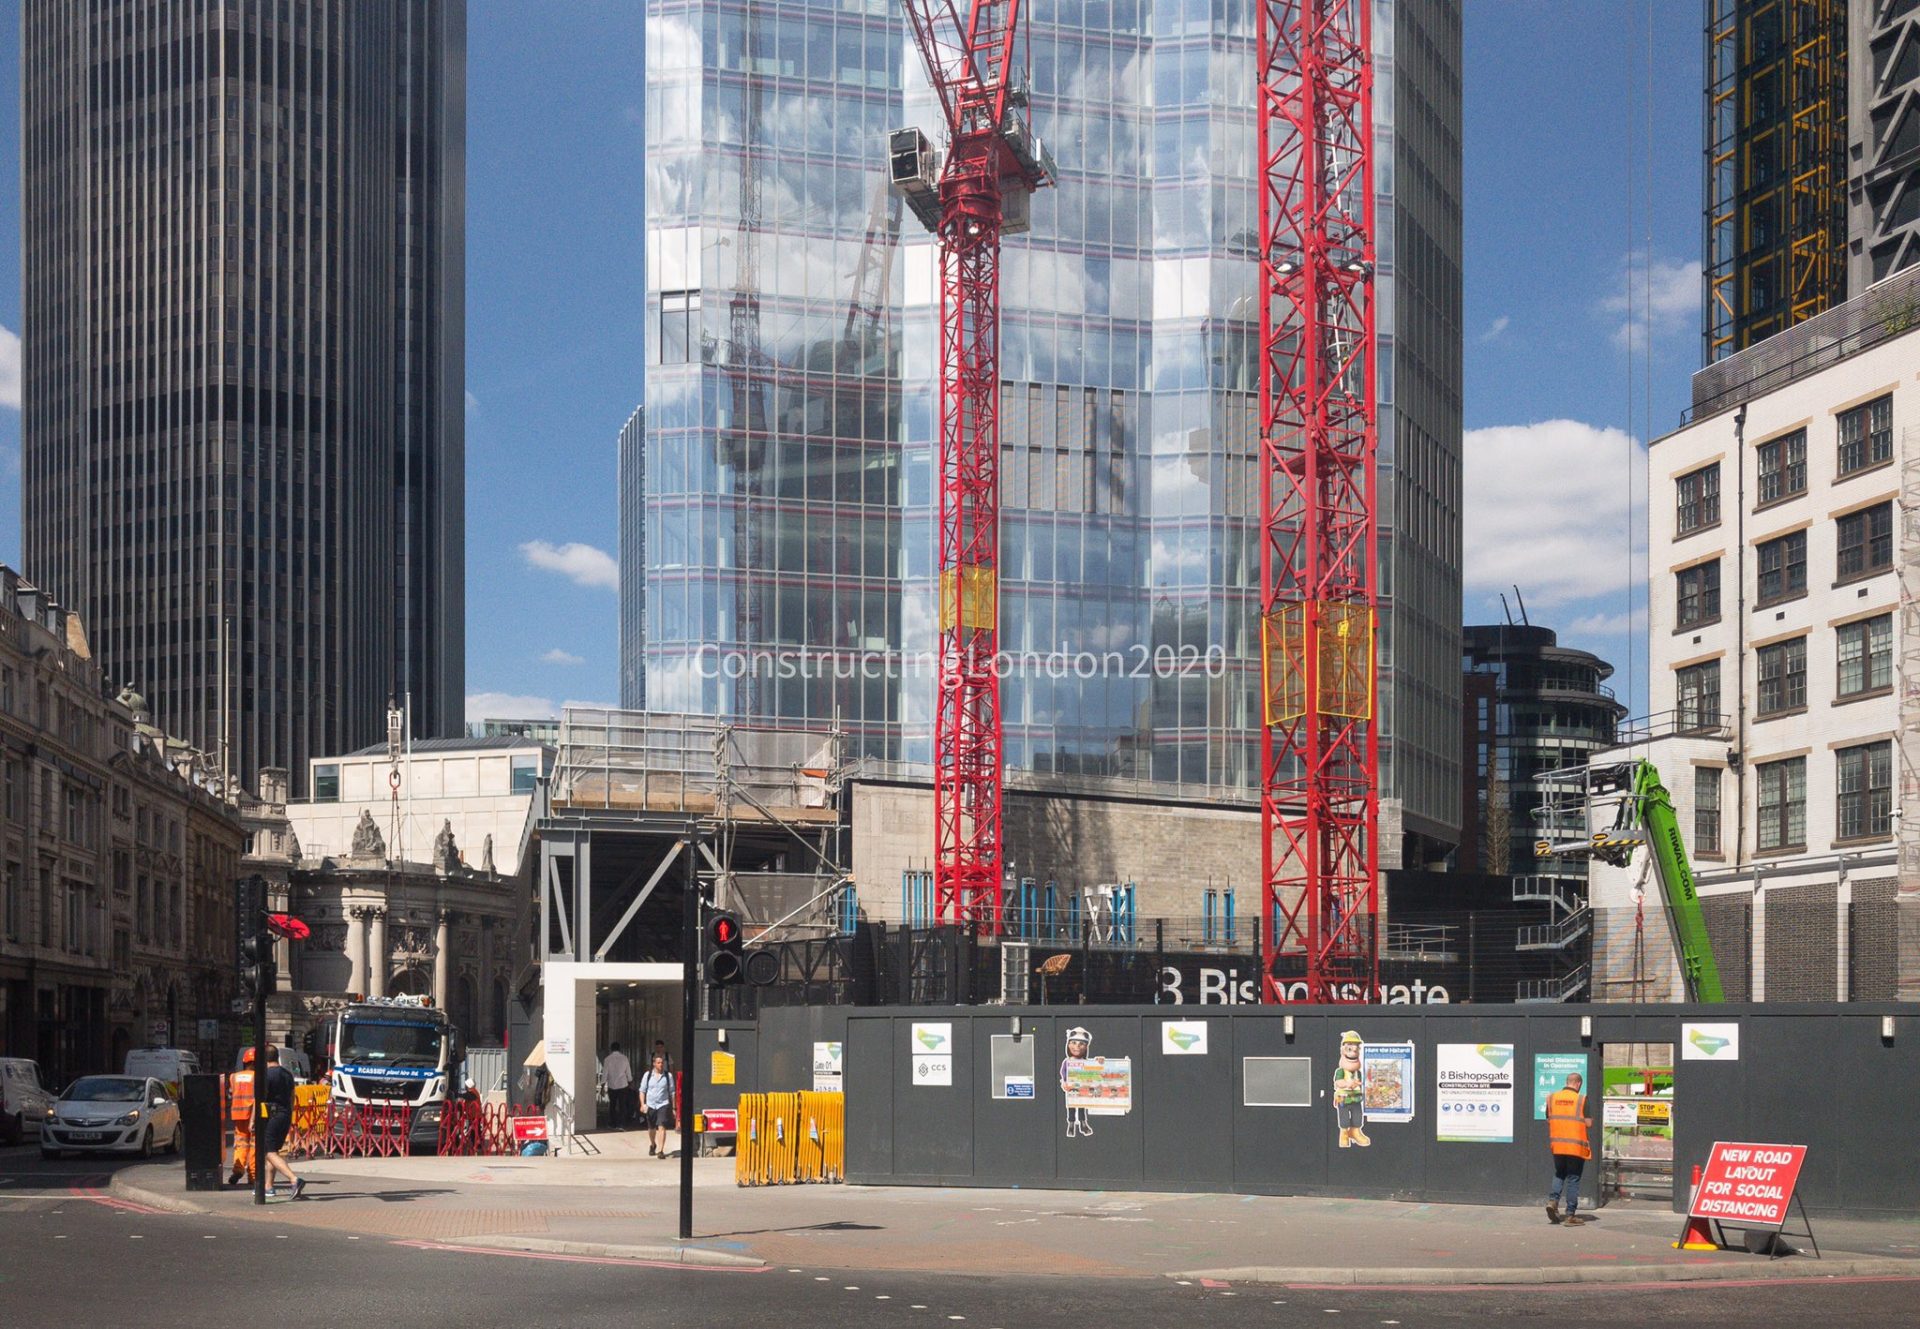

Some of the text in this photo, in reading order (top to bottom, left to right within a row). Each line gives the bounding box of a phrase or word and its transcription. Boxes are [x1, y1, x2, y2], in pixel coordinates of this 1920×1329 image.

[1668, 827, 1693, 901] RIWAL.COM
[1440, 1071, 1510, 1083] 8 Bishopsgate
[1720, 1149, 1792, 1165] NEW ROAD
[1725, 1166, 1776, 1181] LAYOUT
[1705, 1181, 1784, 1199] FOR SOCIAL
[1700, 1199, 1778, 1218] DISTANCING
